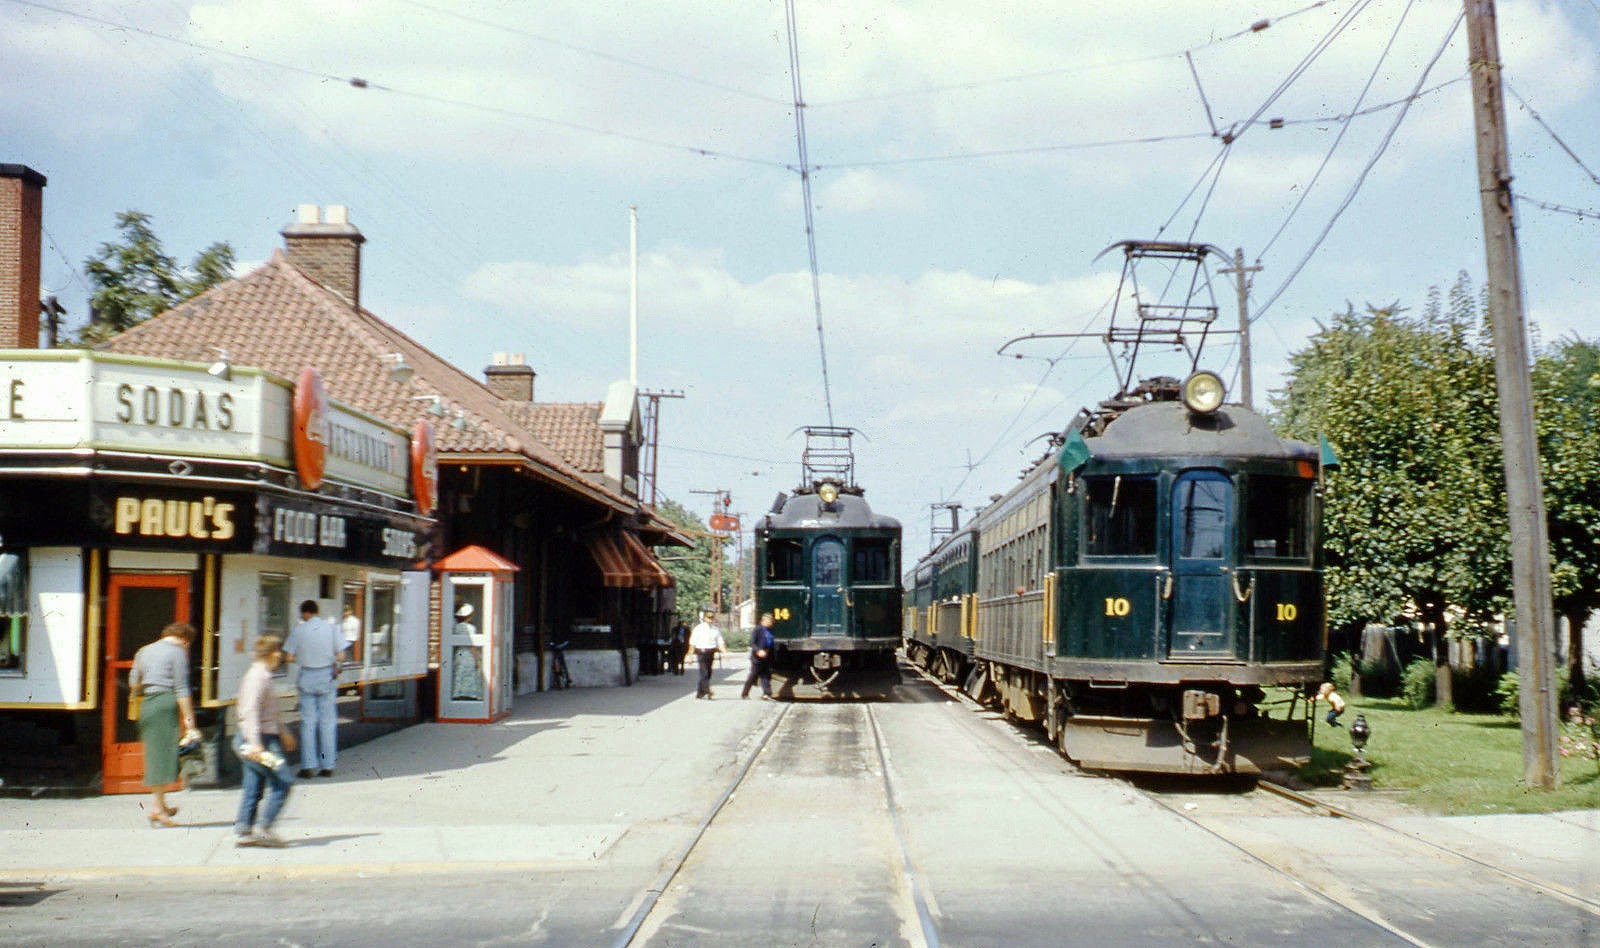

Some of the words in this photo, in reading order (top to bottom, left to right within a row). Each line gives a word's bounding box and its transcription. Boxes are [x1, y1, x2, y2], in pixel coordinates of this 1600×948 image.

[9, 379, 25, 420] E
[116, 383, 234, 432] SODAS
[115, 496, 236, 540] PAUL'S
[274, 507, 317, 545] FOOD
[1104, 597, 1131, 617] 10
[1276, 603, 1298, 621] 10
